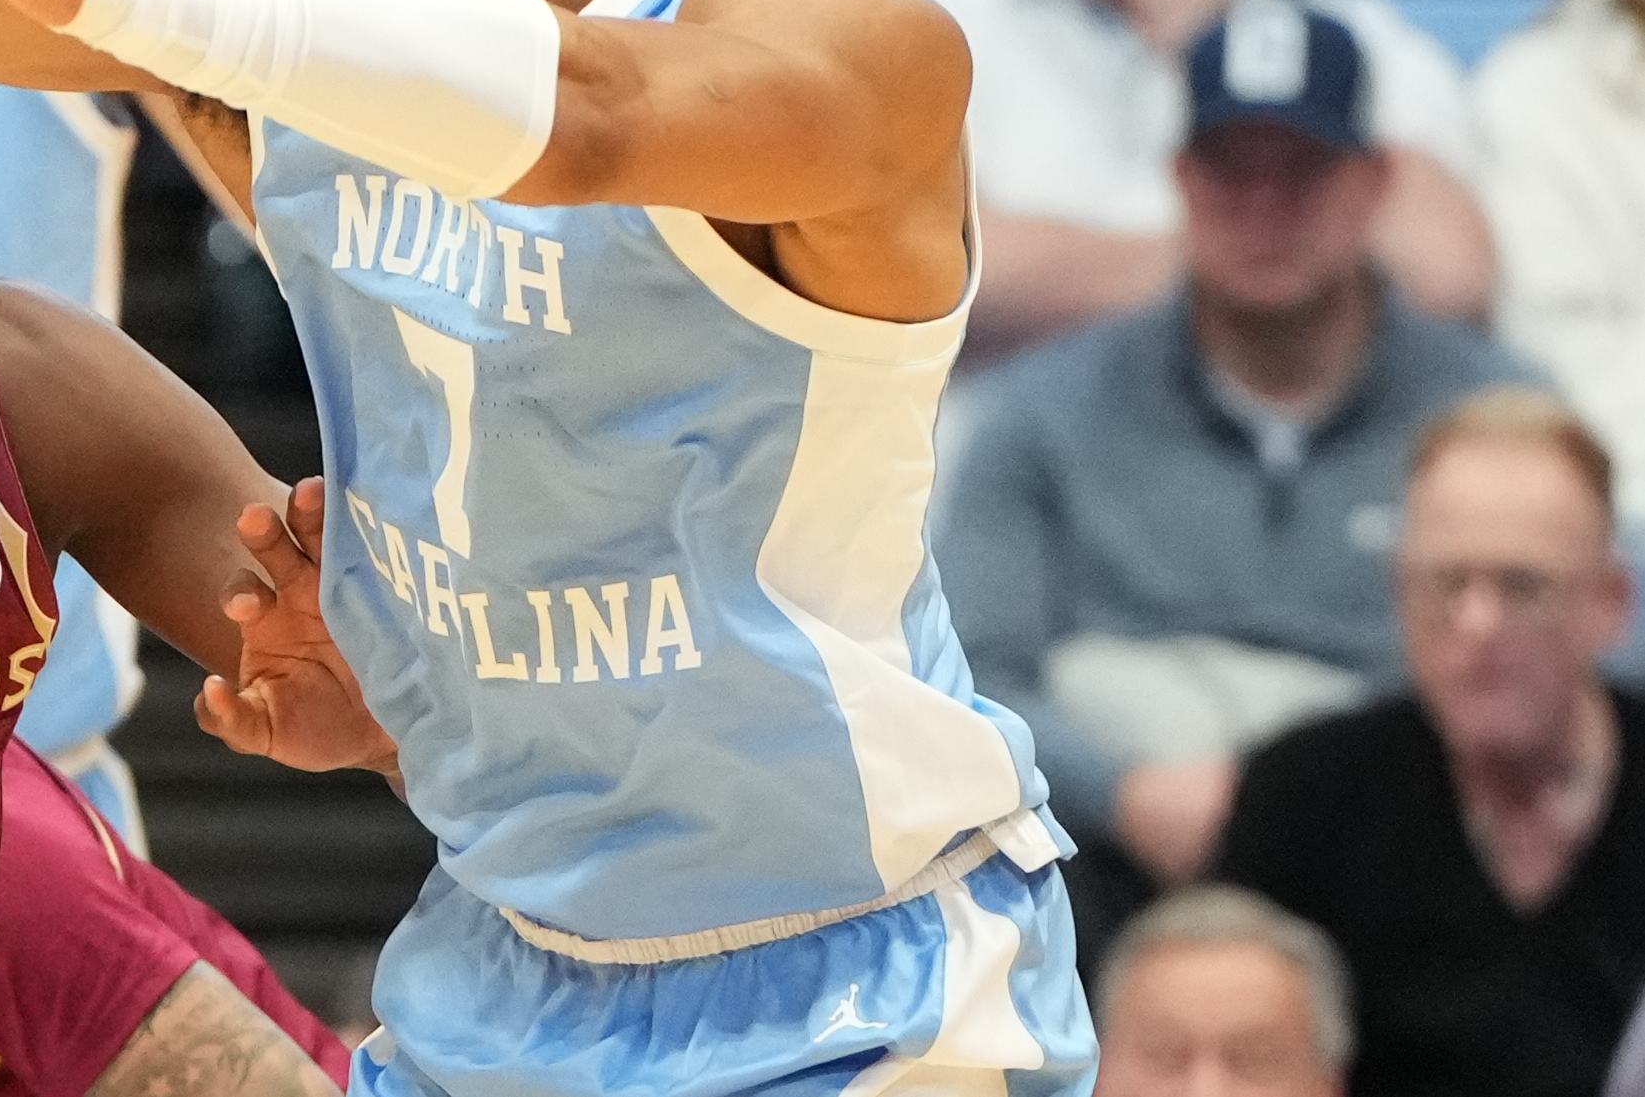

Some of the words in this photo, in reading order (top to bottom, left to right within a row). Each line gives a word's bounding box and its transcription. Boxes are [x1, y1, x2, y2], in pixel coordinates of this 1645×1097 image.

[332, 174, 572, 335] NORTH
[391, 304, 475, 560] 7
[345, 487, 702, 683] CARLINA
